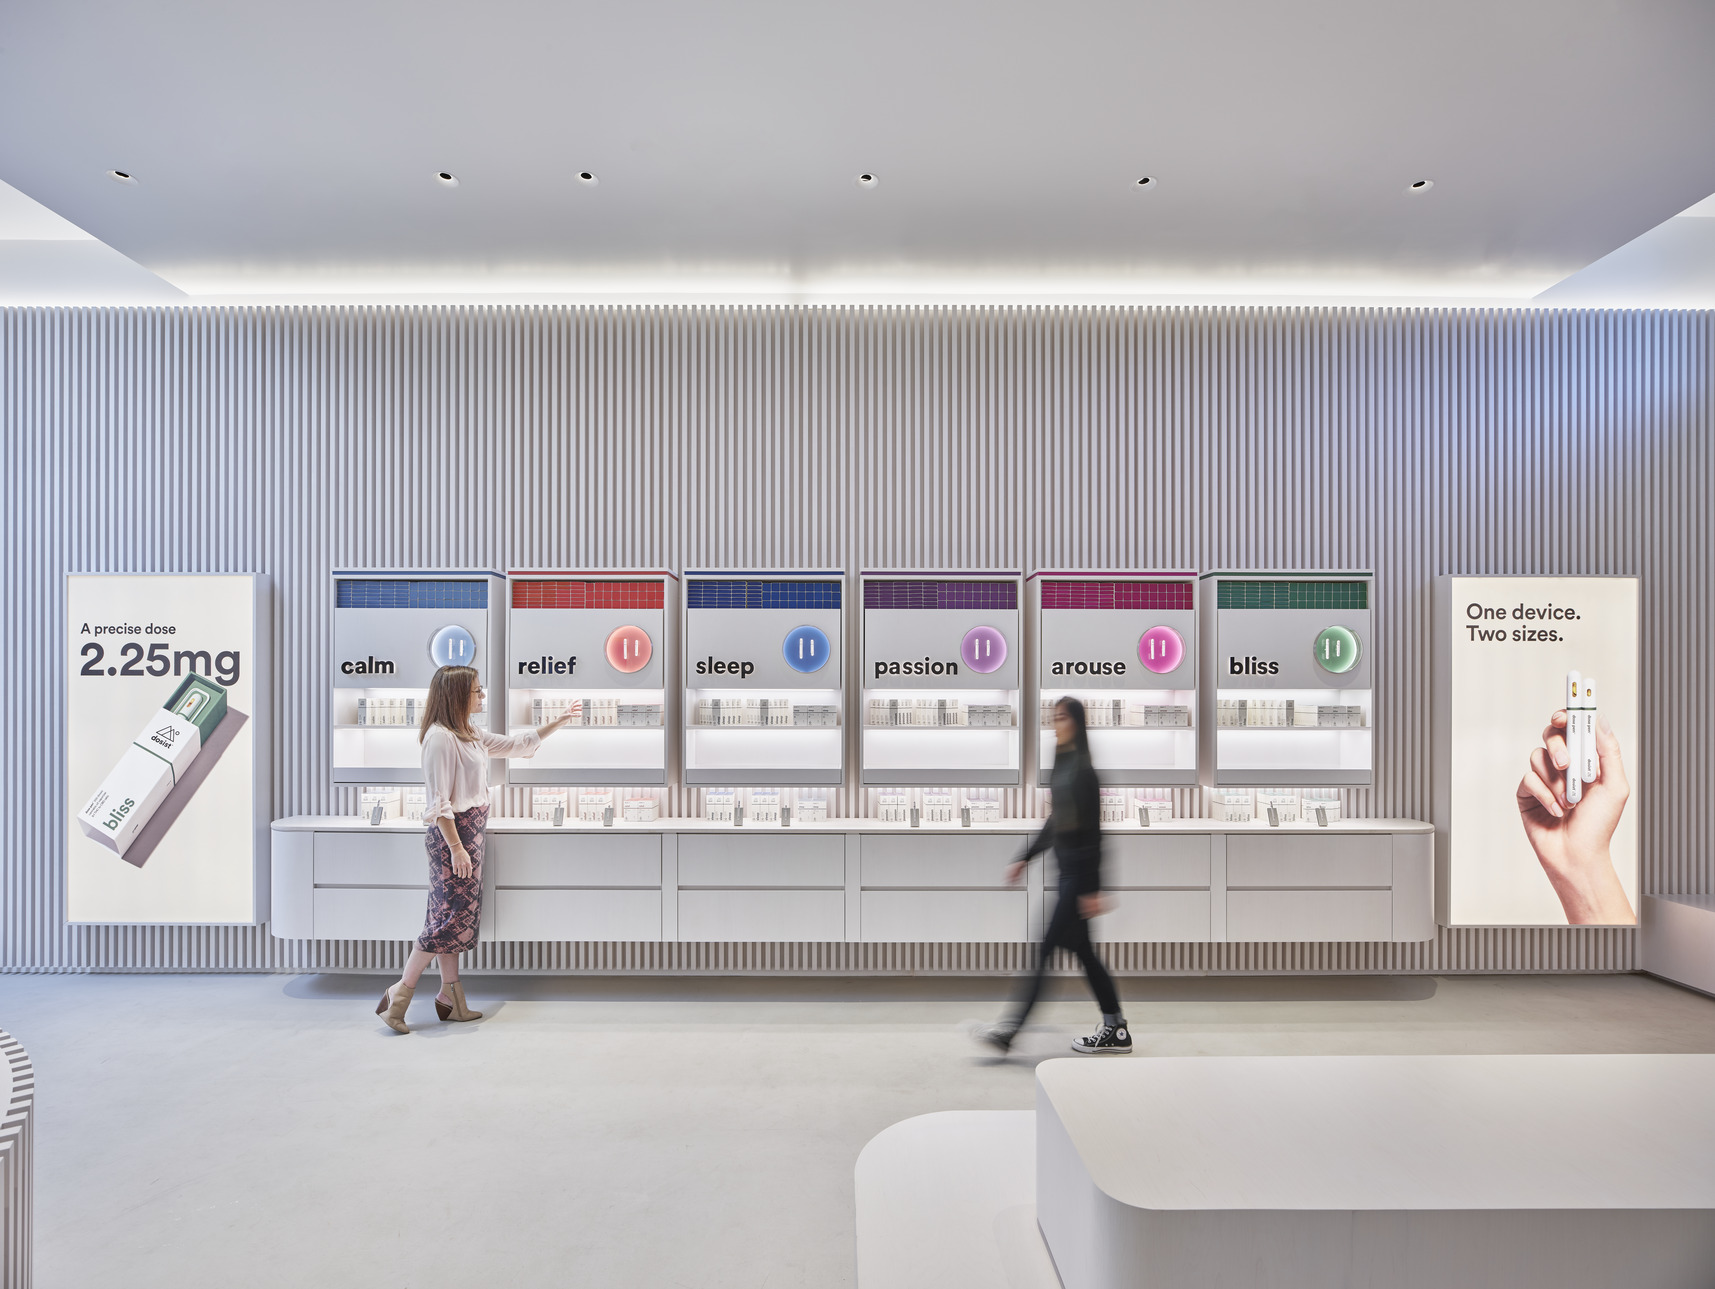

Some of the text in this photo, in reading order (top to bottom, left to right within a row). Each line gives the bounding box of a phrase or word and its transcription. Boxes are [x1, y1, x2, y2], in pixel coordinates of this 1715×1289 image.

[1466, 602, 1581, 620] One device.
[80, 622, 177, 637] A precise dose
[1466, 624, 1564, 642] Two sizes.
[80, 642, 240, 686] 2.25mg
[340, 655, 395, 675] calm
[518, 655, 577, 675] relief
[695, 656, 755, 679] sleep
[874, 656, 958, 679] passion
[1051, 661, 1126, 675] arouse
[1229, 656, 1279, 675] bliss
[150, 735, 172, 749] dosist
[102, 797, 135, 831] bliss
